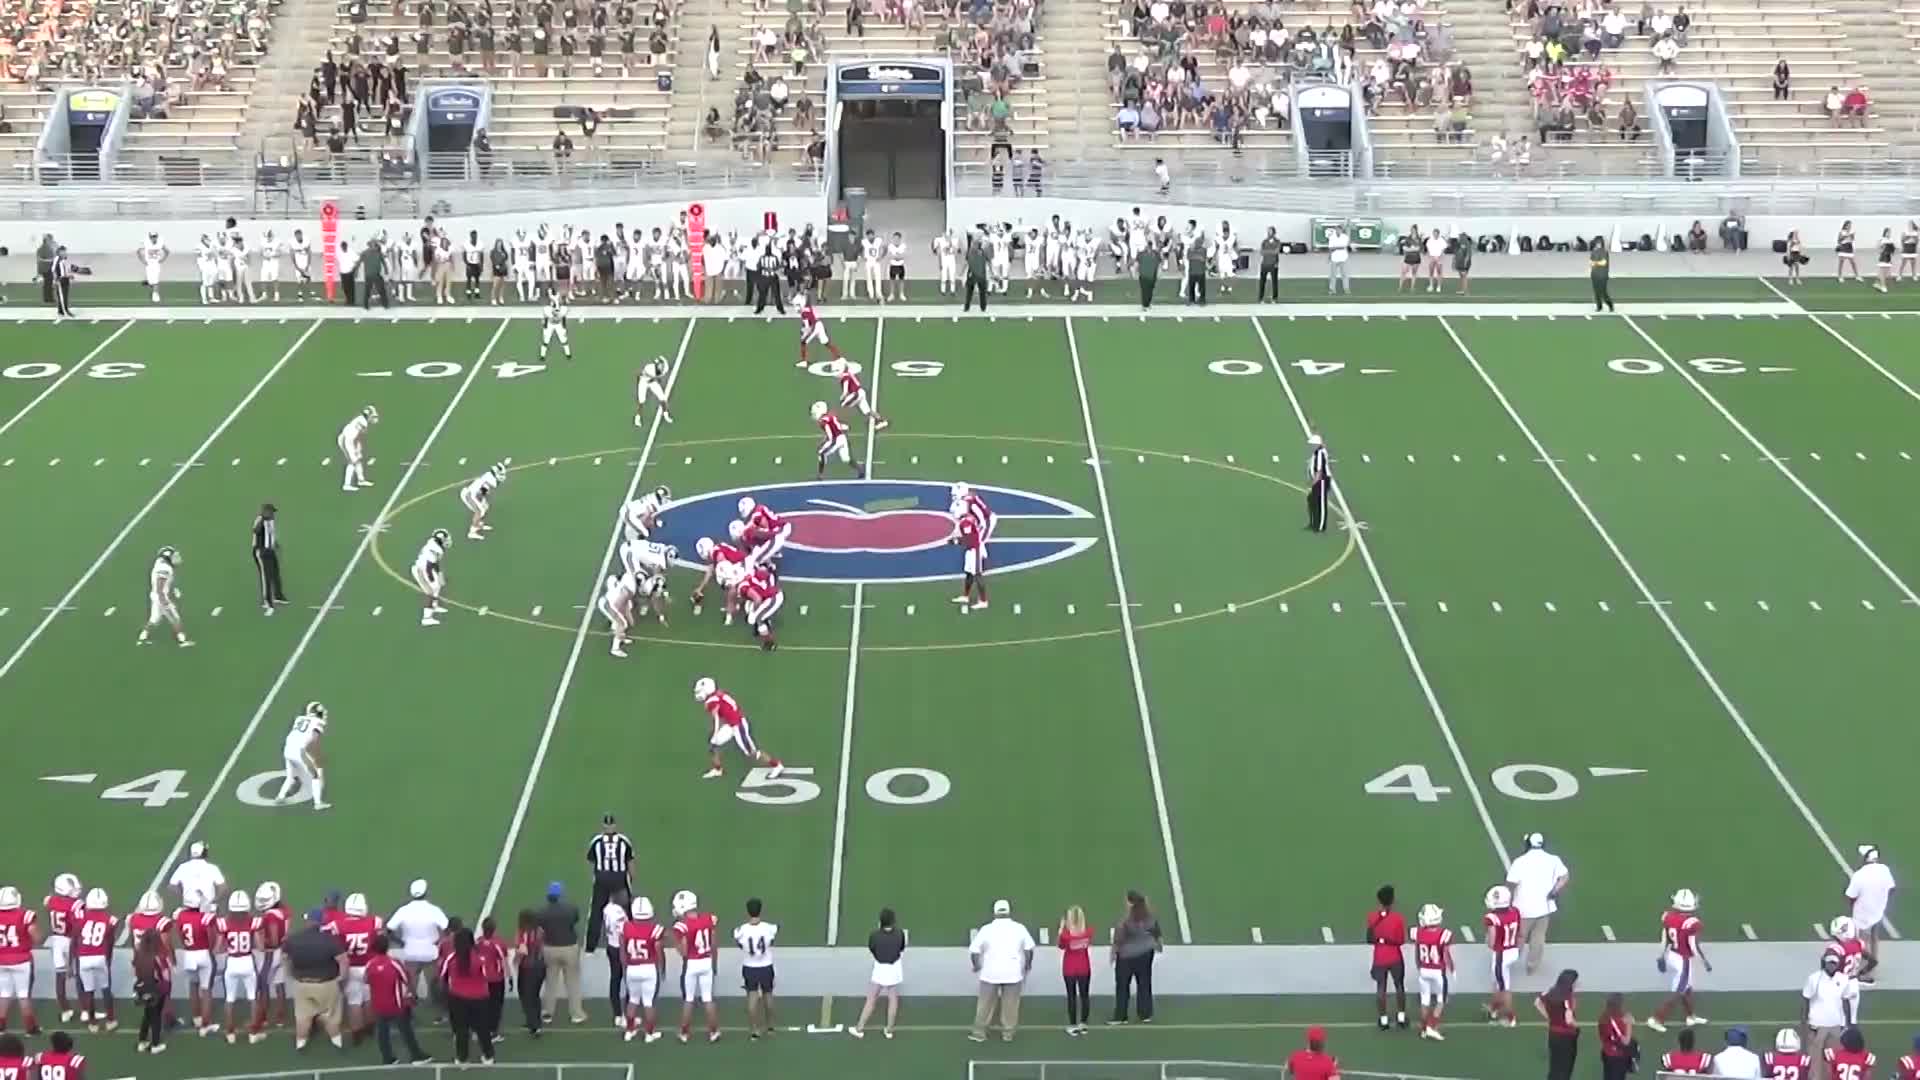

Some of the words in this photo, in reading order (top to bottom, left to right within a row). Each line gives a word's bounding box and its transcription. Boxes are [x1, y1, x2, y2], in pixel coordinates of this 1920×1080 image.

[736, 767, 951, 805] 50
[1364, 764, 1579, 802] 40
[604, 842, 617, 859] H
[50, 911, 66, 934] 15
[82, 920, 107, 947] 48
[182, 923, 194, 946] 3
[345, 932, 368, 956] 75
[694, 928, 711, 954] 41
[747, 935, 766, 956] 14
[1503, 922, 1518, 948] 17
[627, 938, 649, 960] 45
[1420, 944, 1440, 965] 84
